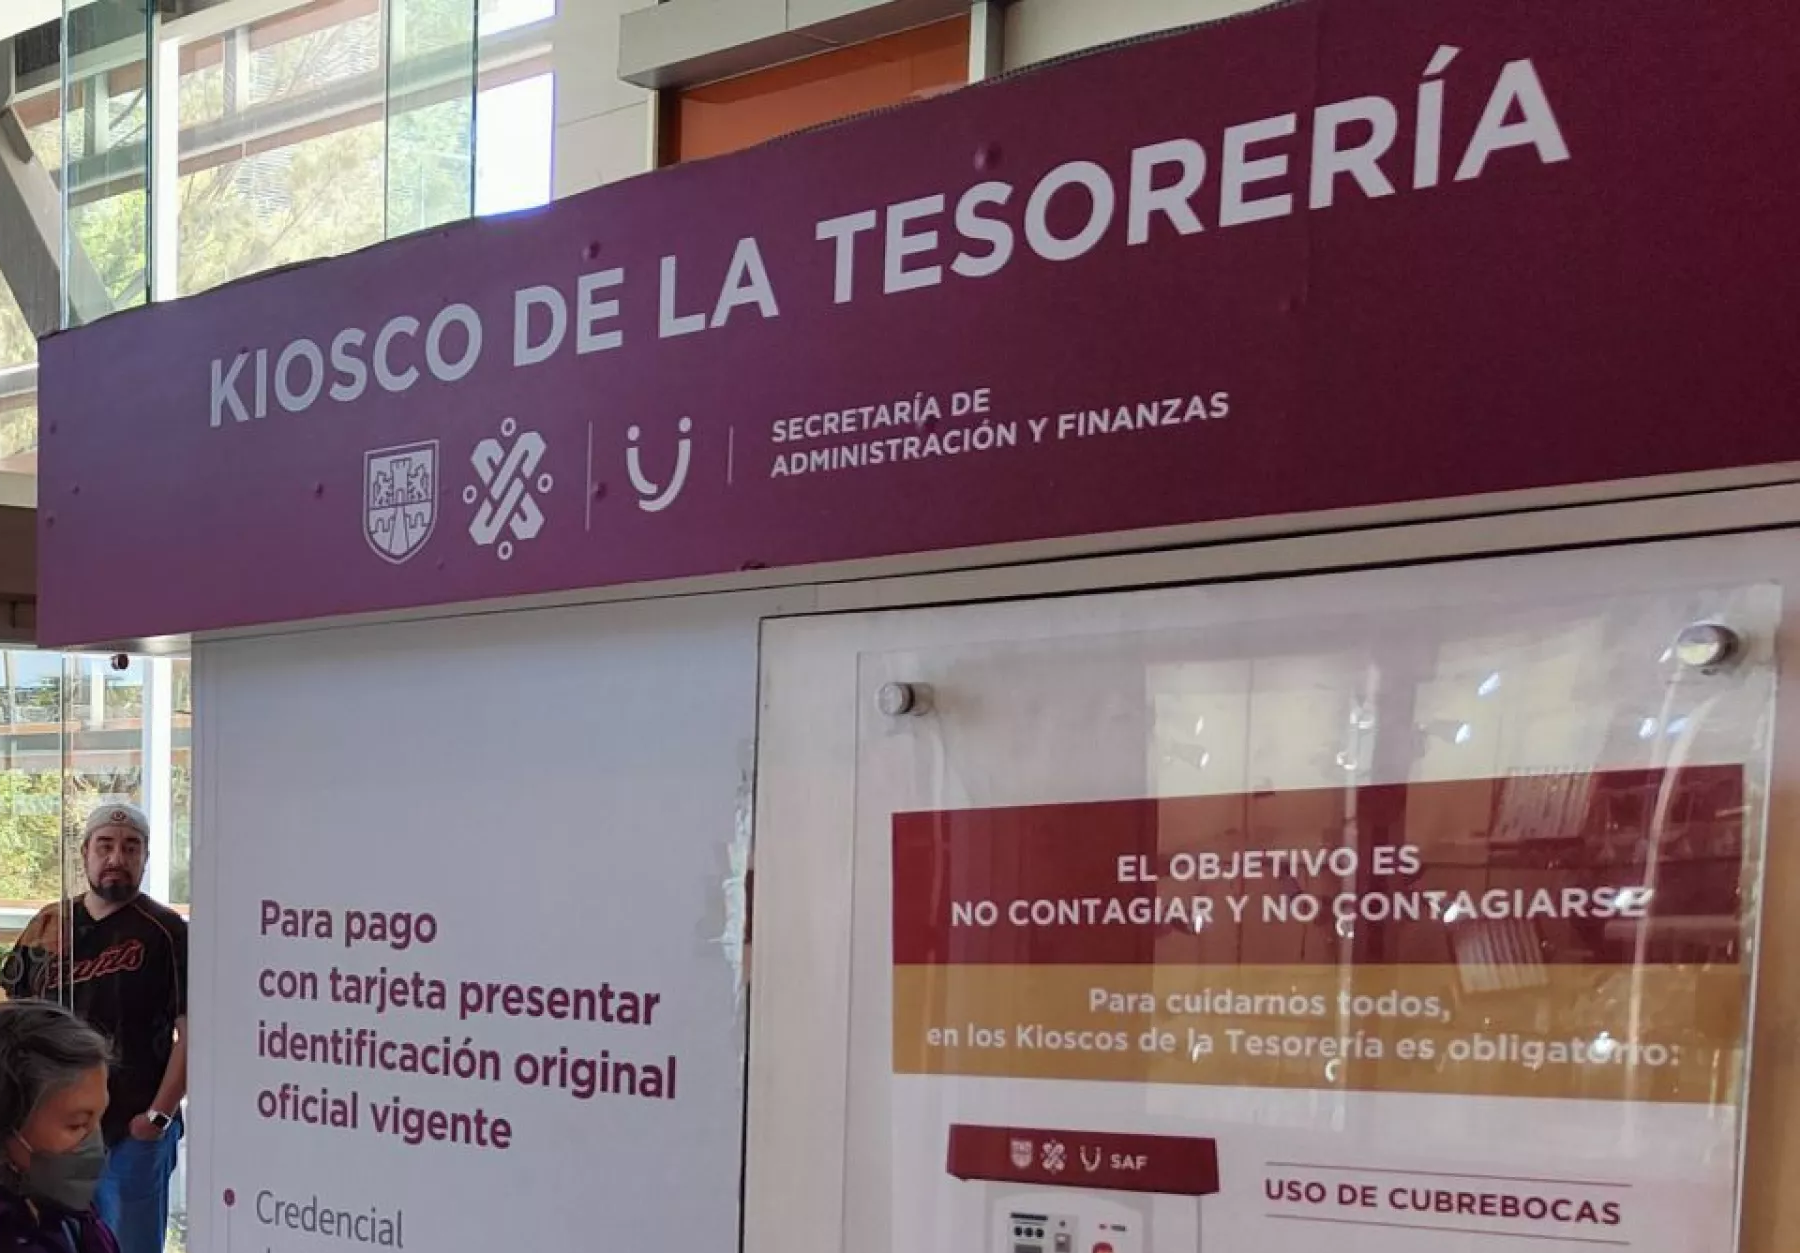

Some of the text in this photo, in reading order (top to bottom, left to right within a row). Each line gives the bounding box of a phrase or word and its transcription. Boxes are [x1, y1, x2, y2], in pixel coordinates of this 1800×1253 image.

[211, 45, 1572, 426] KIOSCO DE LA TESORERÍA
[771, 391, 1229, 478] ADMINISTRACIÓN Y FINANZAS
[772, 387, 991, 443] SECRETARÍA DE
[1117, 844, 1420, 882] EL OBJETIVO ES
[261, 899, 438, 951] Para pago
[952, 885, 1654, 927] NO CONTAGIAR Y NO CONTAGIARSE
[258, 966, 661, 1026] con tarjeta presentar
[1089, 987, 1451, 1023] Para cuidarnos todos,
[259, 1020, 676, 1100] identificación original
[926, 1028, 959, 1047] en
[968, 1022, 1006, 1049] los
[1016, 1024, 1128, 1051] Kioscos
[1139, 1026, 1176, 1052] de
[1188, 1027, 1215, 1054] la
[1224, 1029, 1383, 1059] Tesorería
[1396, 1038, 1435, 1060] es
[258, 1083, 513, 1150] oficial vigente
[1111, 1153, 1148, 1170] SAF
[256, 1189, 404, 1249] Credencial
[1265, 1178, 1621, 1225] USO DE CUBREBOCAS
